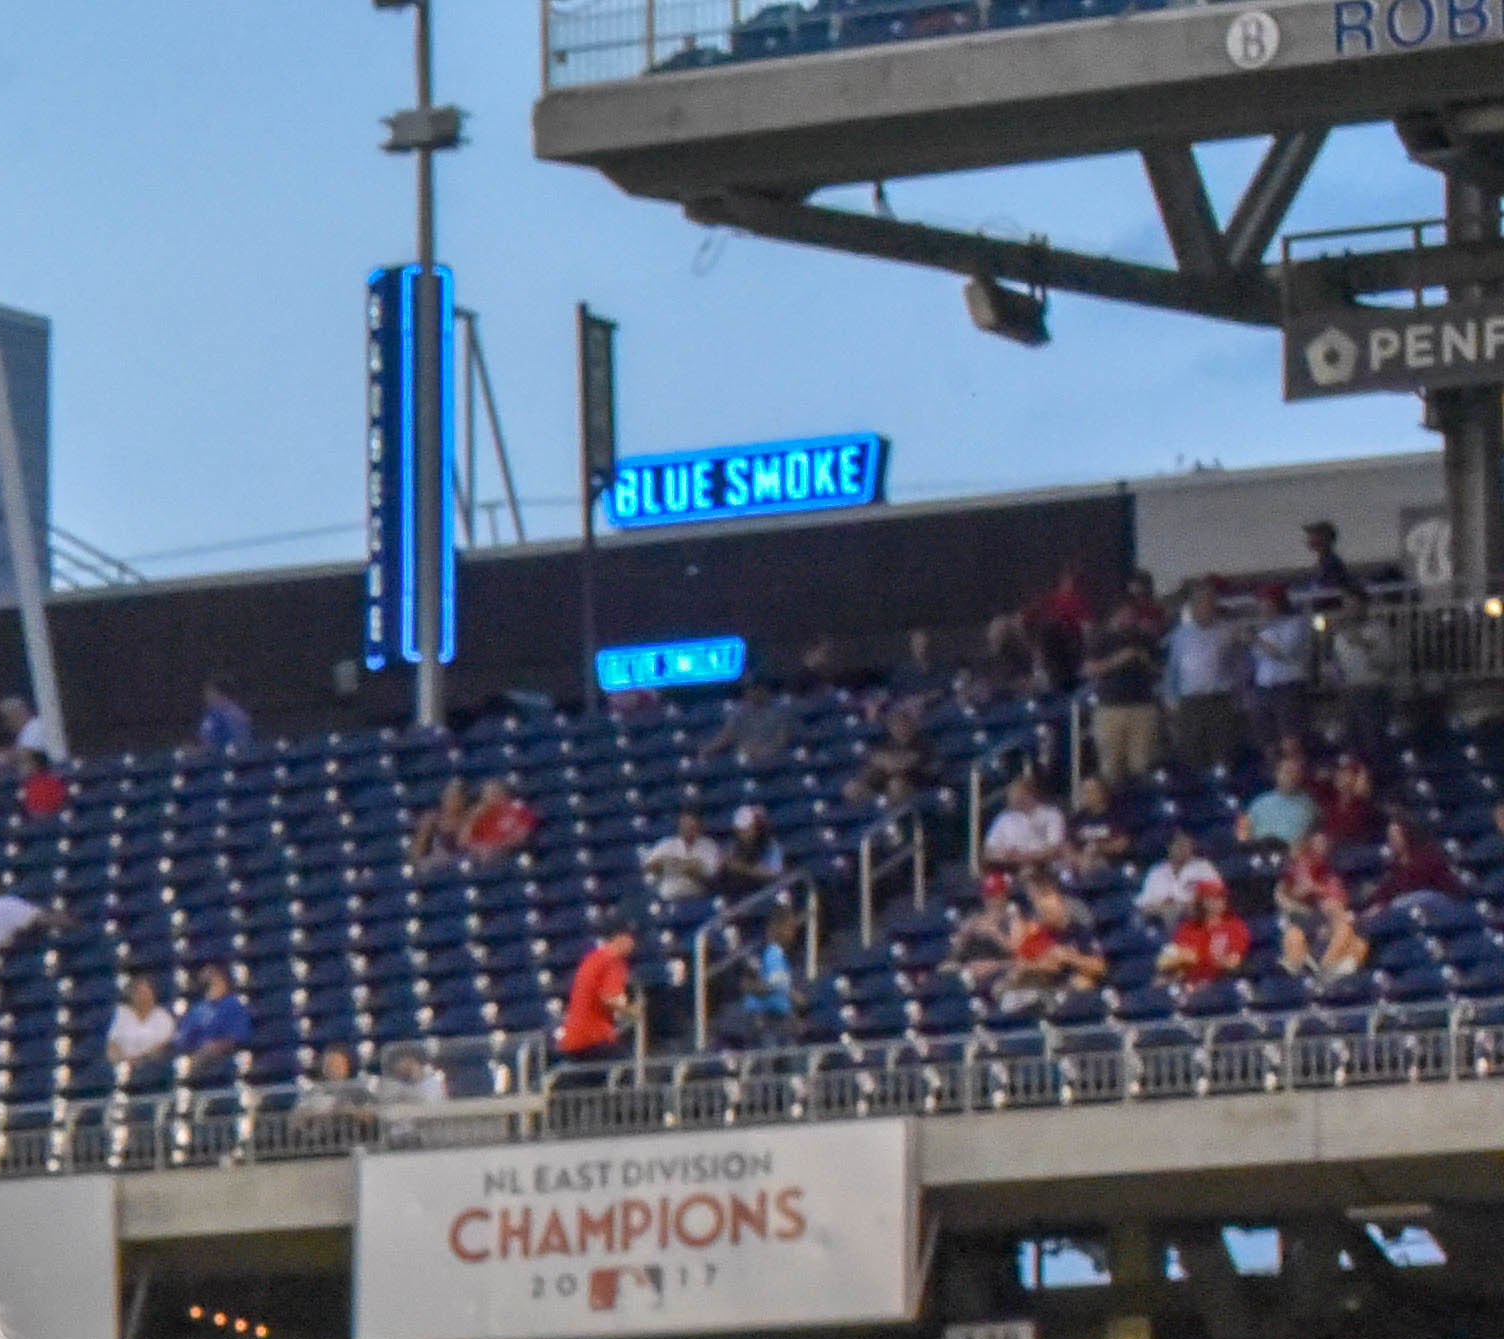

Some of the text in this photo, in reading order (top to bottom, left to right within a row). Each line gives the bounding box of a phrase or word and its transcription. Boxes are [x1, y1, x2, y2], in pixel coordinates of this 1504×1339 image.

[1335, 0, 1504, 54] ROB
[614, 444, 863, 518] BLUE SMOKE
[483, 1149, 774, 1198] NL EAST DIVISION
[447, 1185, 808, 1264] CHAMPIONS
